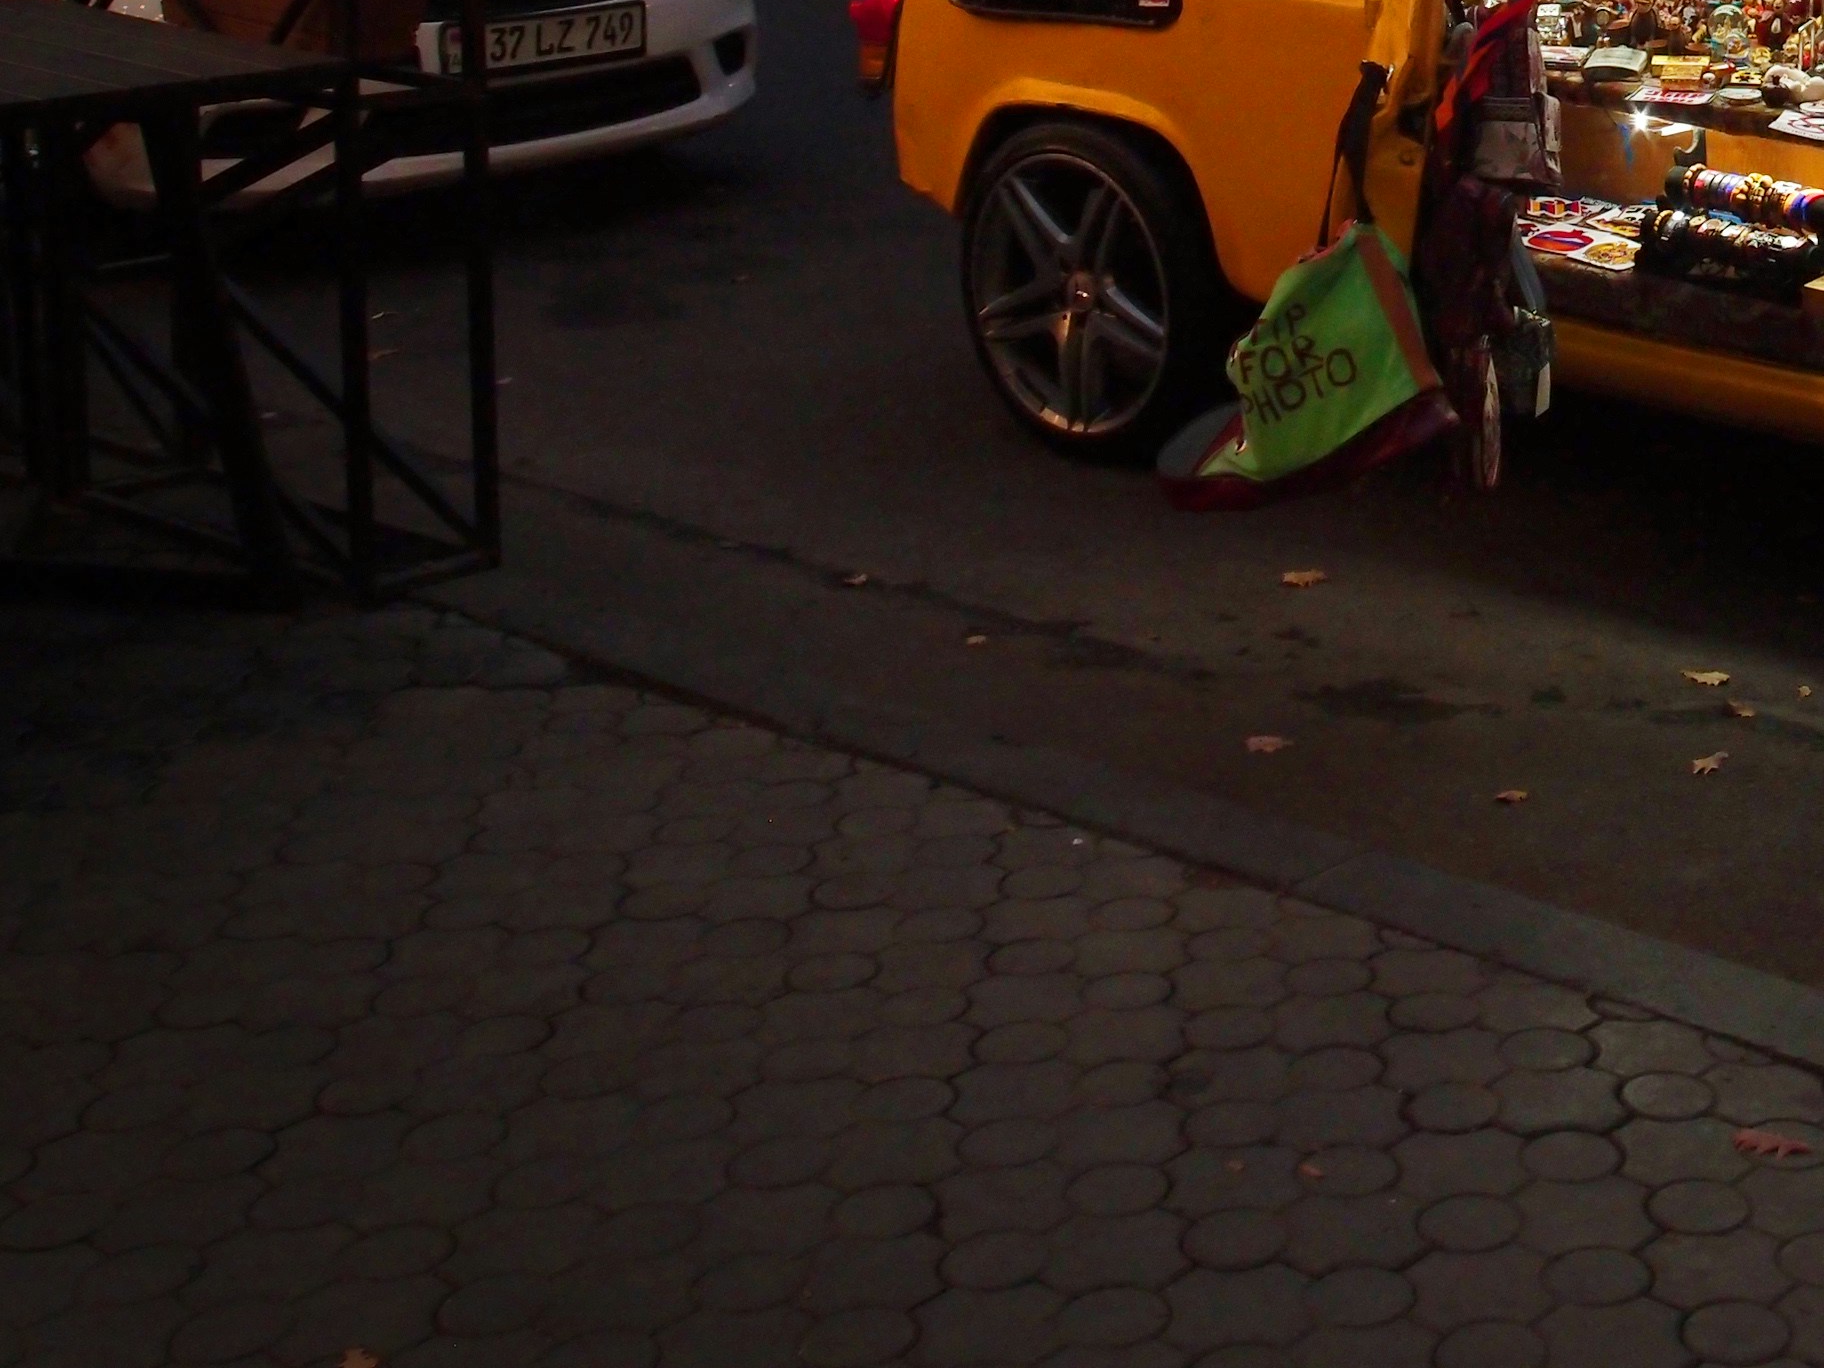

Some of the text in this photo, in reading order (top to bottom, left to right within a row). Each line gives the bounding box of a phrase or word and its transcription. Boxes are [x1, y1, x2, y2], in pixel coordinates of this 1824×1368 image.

[489, 11, 635, 62] 37 LZ 749
[1250, 303, 1306, 346] TIP
[1238, 334, 1325, 385] FOR
[1239, 347, 1357, 425] PHOTO
